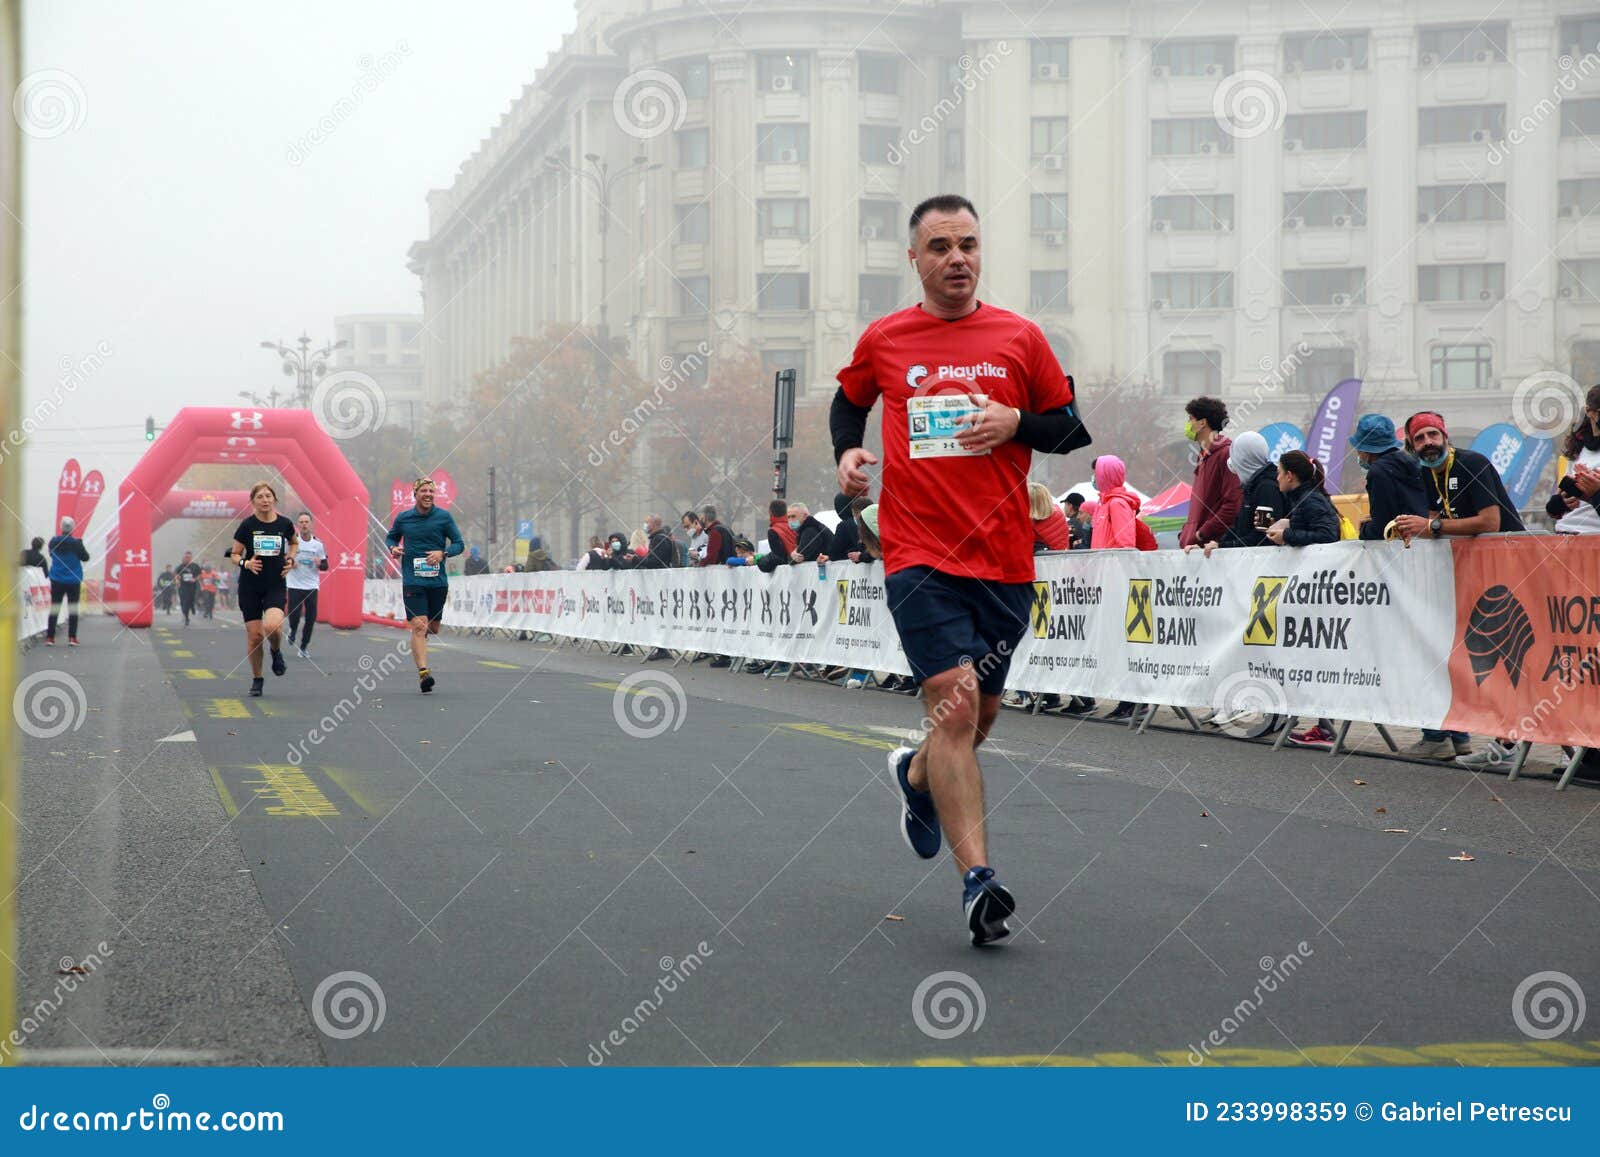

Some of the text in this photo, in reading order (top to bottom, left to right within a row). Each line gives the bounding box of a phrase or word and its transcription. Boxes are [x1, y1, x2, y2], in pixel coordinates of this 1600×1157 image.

[938, 362, 1007, 380] Playtika
[1318, 396, 1342, 477] uru.ro
[1154, 576, 1223, 607] Raiffeisen
[1282, 570, 1391, 606] Raiffeisen
[1048, 615, 1086, 641] BANK
[1157, 617, 1197, 646] BANK
[1282, 616, 1352, 650] BANK
[1316, 670, 1340, 684] cum
[1343, 667, 1381, 687] trebuie
